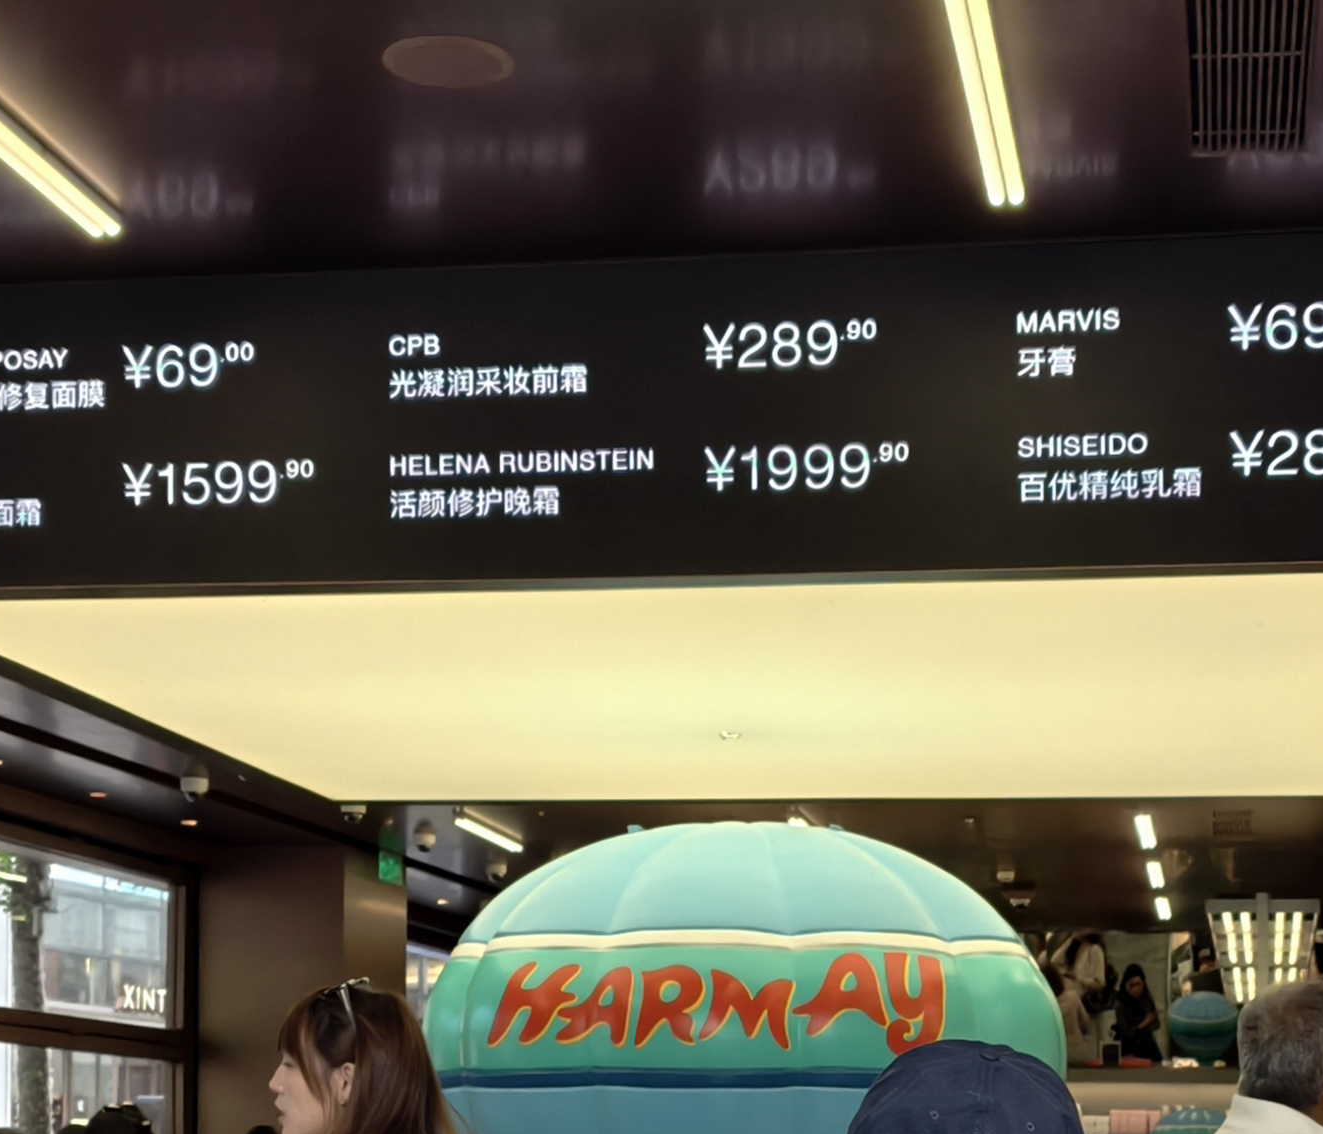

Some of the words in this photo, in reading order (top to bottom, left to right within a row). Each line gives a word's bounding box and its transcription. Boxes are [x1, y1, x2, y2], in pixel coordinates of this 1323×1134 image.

[1016, 307, 1121, 335] MARVIS
[388, 333, 441, 357] CPB
[1016, 344, 1077, 378] 牙膏
[389, 363, 588, 400] 光凝润采妆前霜
[389, 452, 491, 477] HELENA
[499, 447, 655, 474] RUBINSTEIN
[1017, 432, 1149, 459] SHISEIDO
[1017, 466, 1202, 503] 百优精纯乳霜
[389, 485, 560, 519] 活颜修护晚霜
[487, 951, 946, 1056] HARMAY
